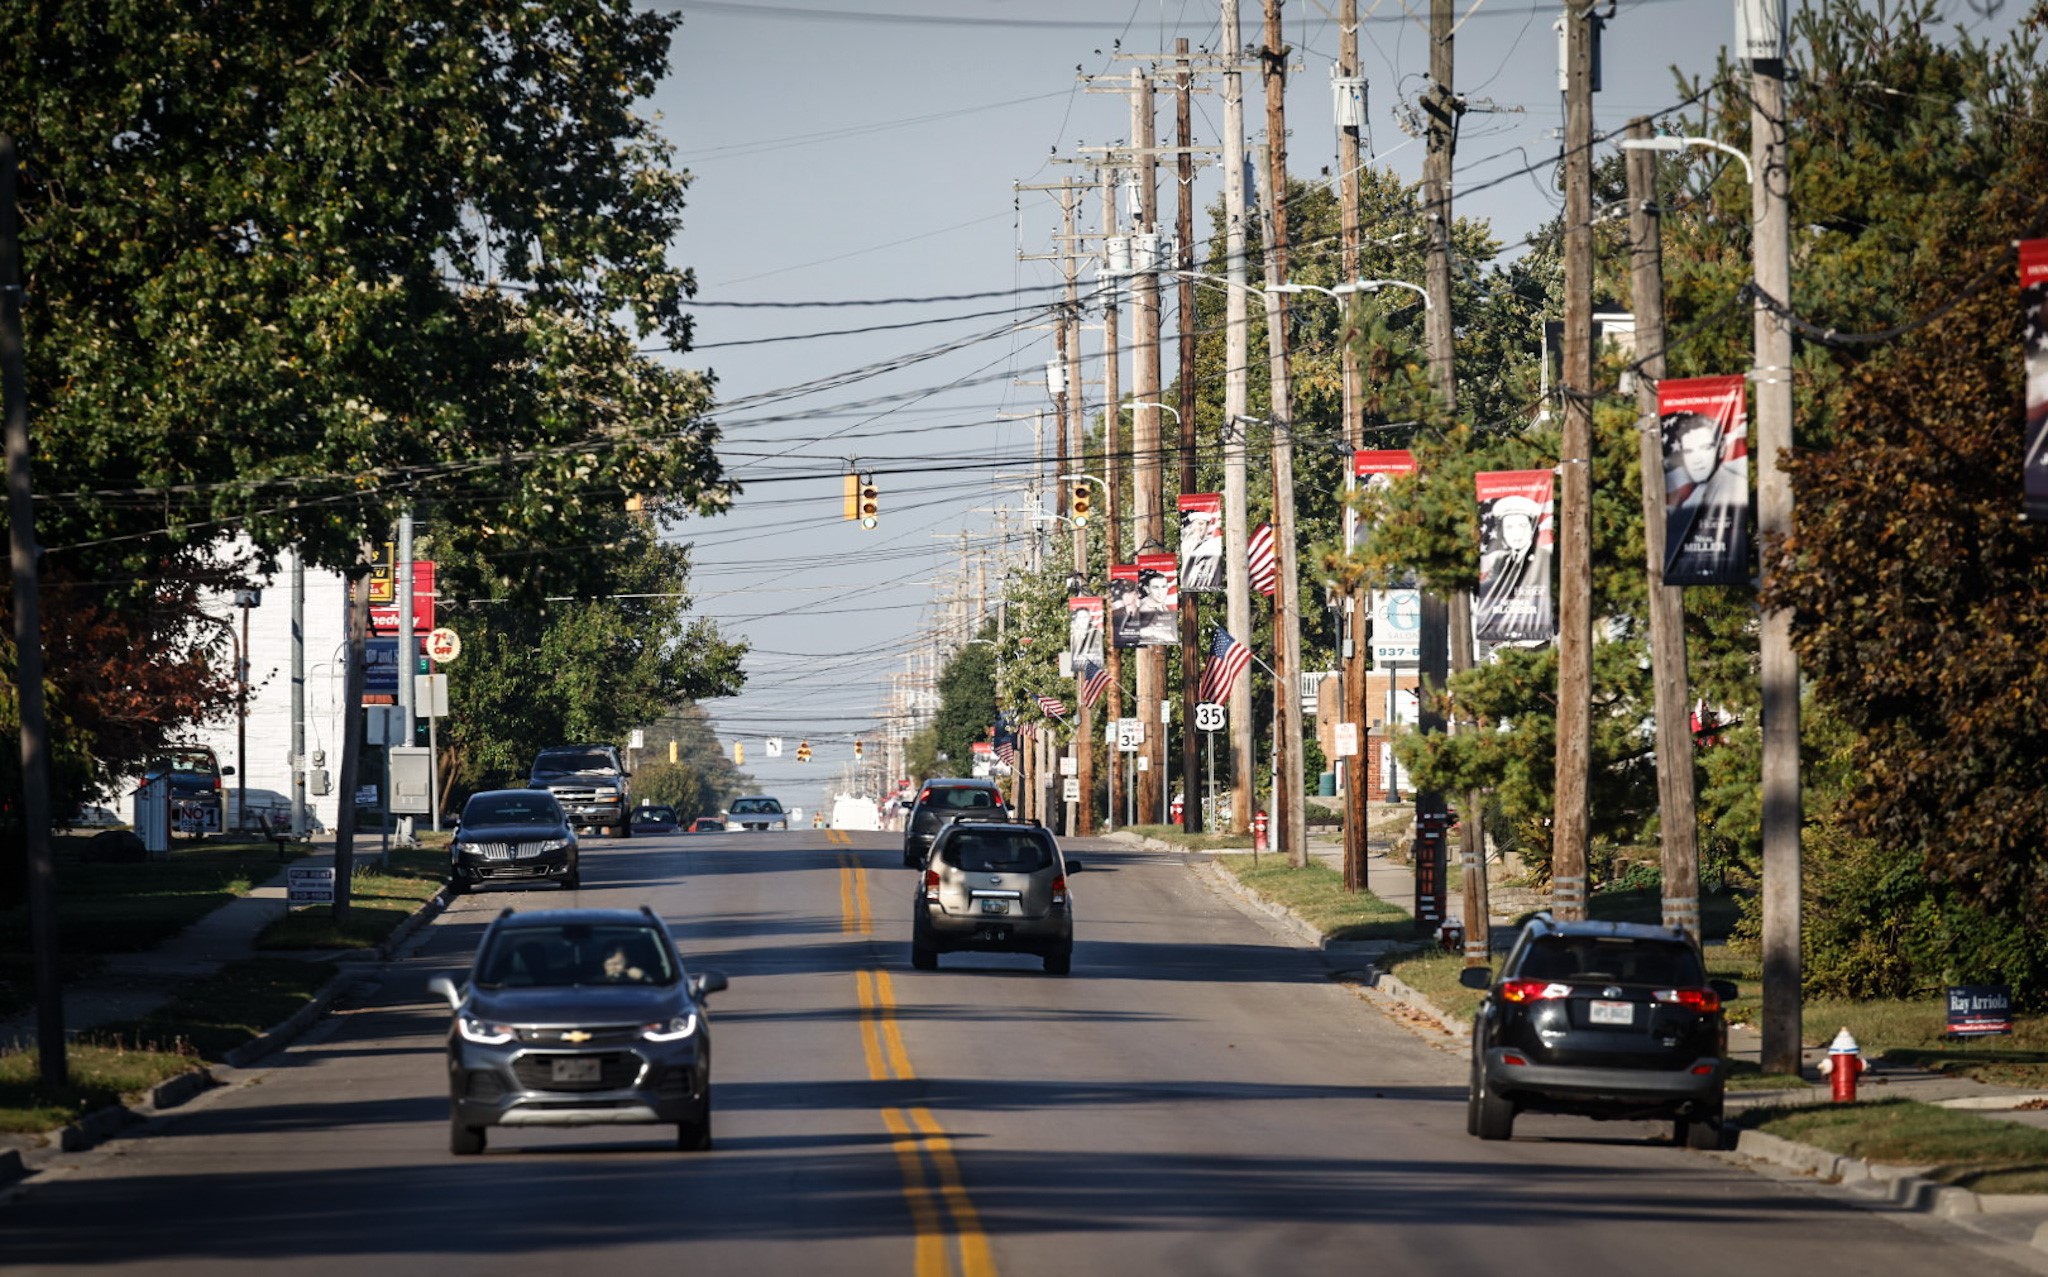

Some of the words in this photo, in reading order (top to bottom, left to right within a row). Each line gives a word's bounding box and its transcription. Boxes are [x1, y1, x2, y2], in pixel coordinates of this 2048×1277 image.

[1684, 542, 1726, 552] MILLER
[434, 647, 453, 655] OFF
[1200, 708, 1221, 725] 35
[182, 807, 204, 820] NO
[205, 808, 217, 827] 1
[1951, 995, 1970, 1014] Ray
[1971, 993, 2008, 1010] Arriola
